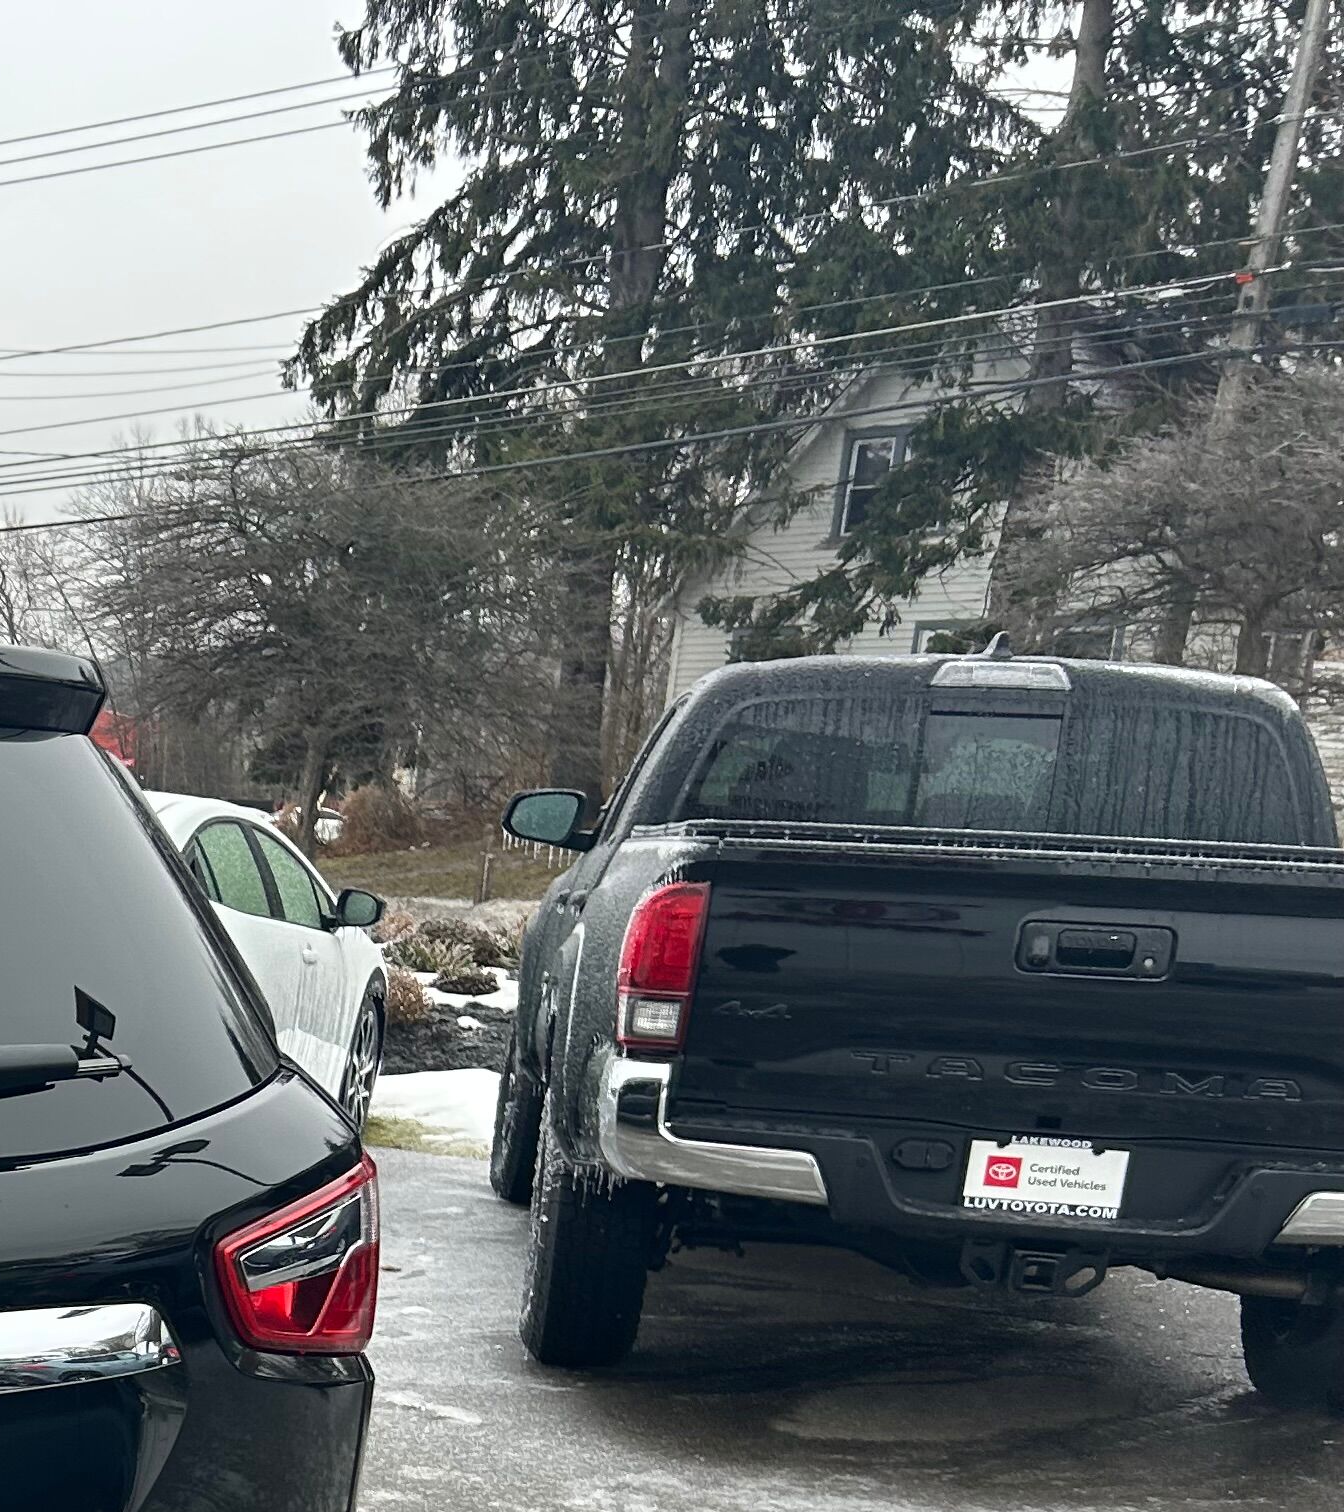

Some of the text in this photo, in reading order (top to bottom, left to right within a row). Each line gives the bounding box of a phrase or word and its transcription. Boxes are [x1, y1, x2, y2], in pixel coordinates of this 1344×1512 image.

[850, 1049, 1304, 1102] TACOMA
[1011, 1135, 1092, 1149] LAKEWOOD
[1029, 1163, 1081, 1176] Certified
[1027, 1177, 1107, 1191] Used Vehicles
[964, 1197, 1118, 1219] LUVTOYOTA.COM
